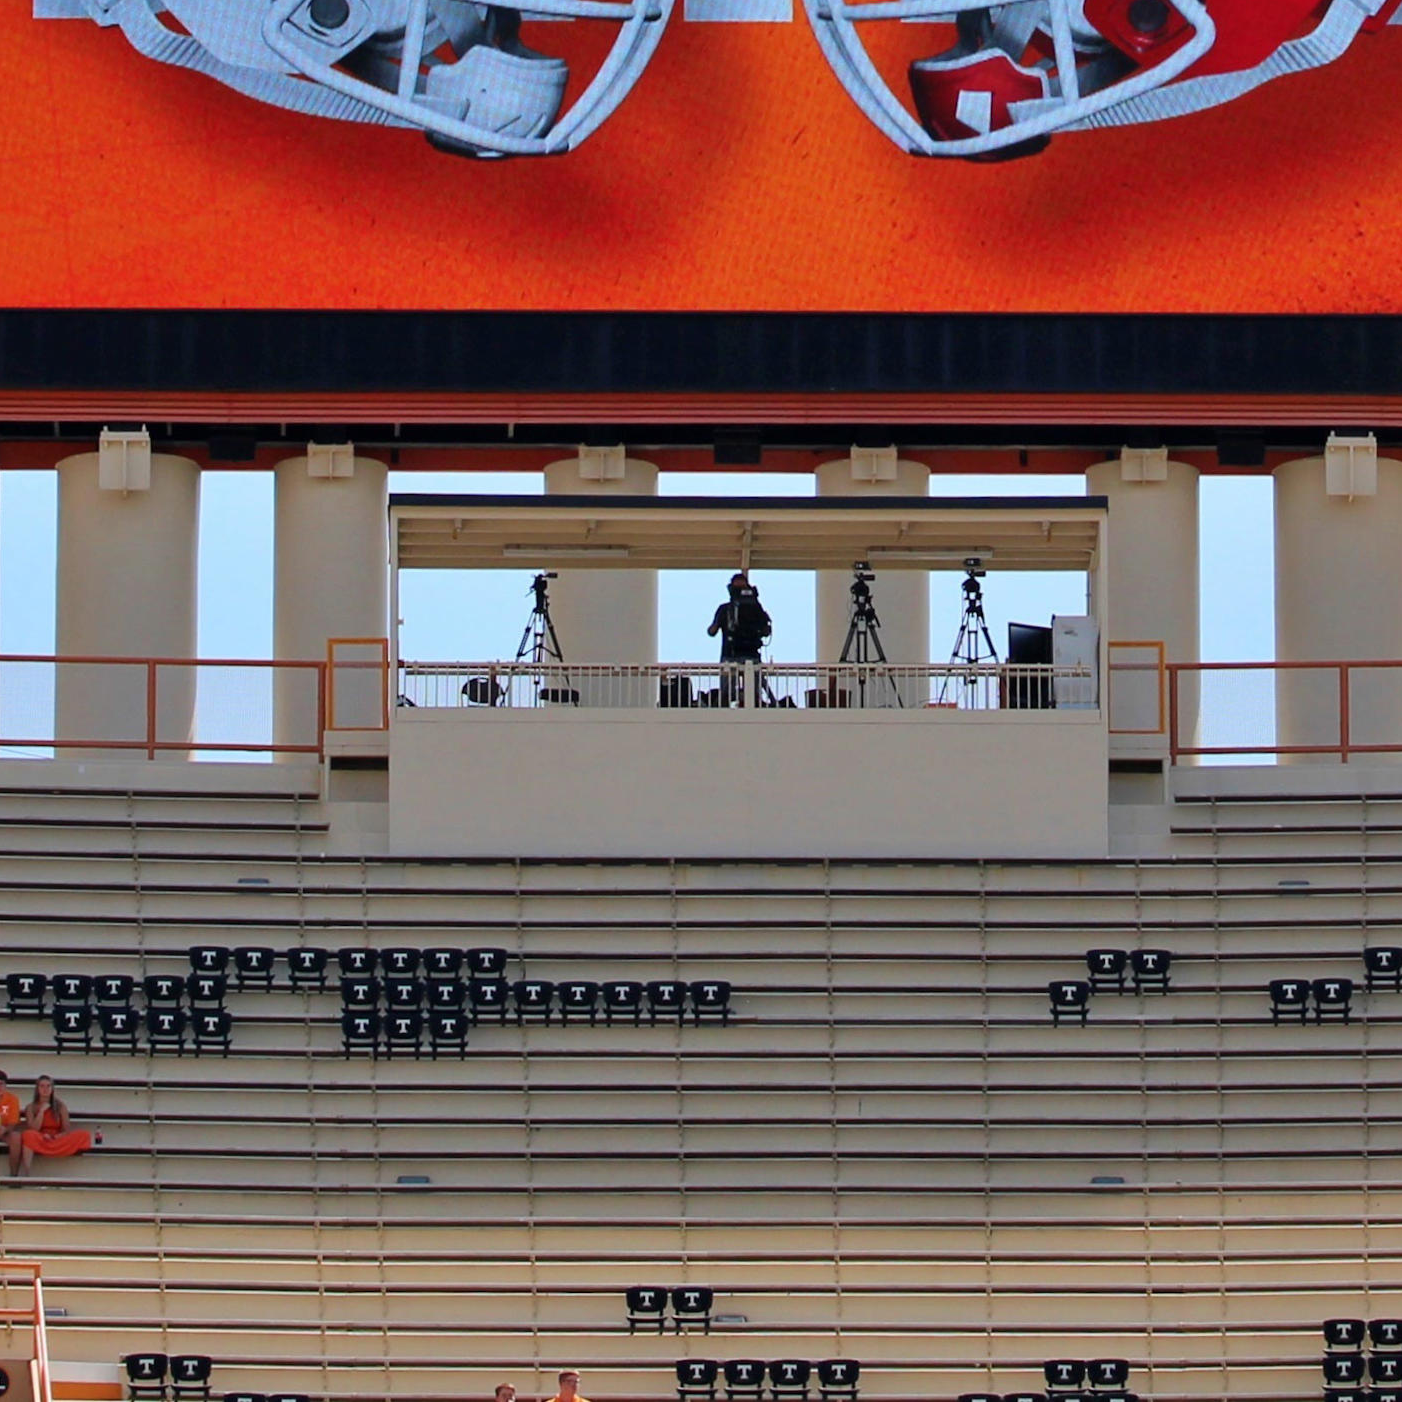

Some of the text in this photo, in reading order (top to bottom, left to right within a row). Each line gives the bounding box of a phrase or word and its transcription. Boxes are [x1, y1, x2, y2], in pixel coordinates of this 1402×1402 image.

[202, 951, 216, 965] T
[300, 953, 314, 966] T
[436, 953, 450, 967] T
[1100, 954, 1113, 968] T
[1143, 955, 1157, 968] T
[1377, 952, 1391, 965] T
[19, 978, 33, 992] T
[107, 980, 121, 994] T
[1283, 985, 1297, 998] T
[1325, 984, 1339, 998] T
[526, 986, 540, 1000] T
[572, 987, 585, 1000] T
[660, 986, 673, 999] T
[704, 986, 718, 1000] T
[1062, 986, 1076, 1000] T
[66, 1013, 79, 1027] T
[204, 1017, 218, 1030] T
[355, 1019, 369, 1033] T
[442, 1019, 456, 1033] T
[640, 1292, 654, 1306] T
[685, 1293, 699, 1306] T
[1337, 1324, 1351, 1338] T
[1382, 1324, 1397, 1339] T
[139, 1359, 154, 1373] T
[183, 1361, 198, 1375] T
[690, 1364, 704, 1378] T
[782, 1364, 797, 1378] T
[832, 1365, 846, 1379] T
[1058, 1365, 1072, 1379] T
[1101, 1364, 1115, 1378] T
[1337, 1362, 1351, 1376] T
[1382, 1361, 1396, 1375] T
